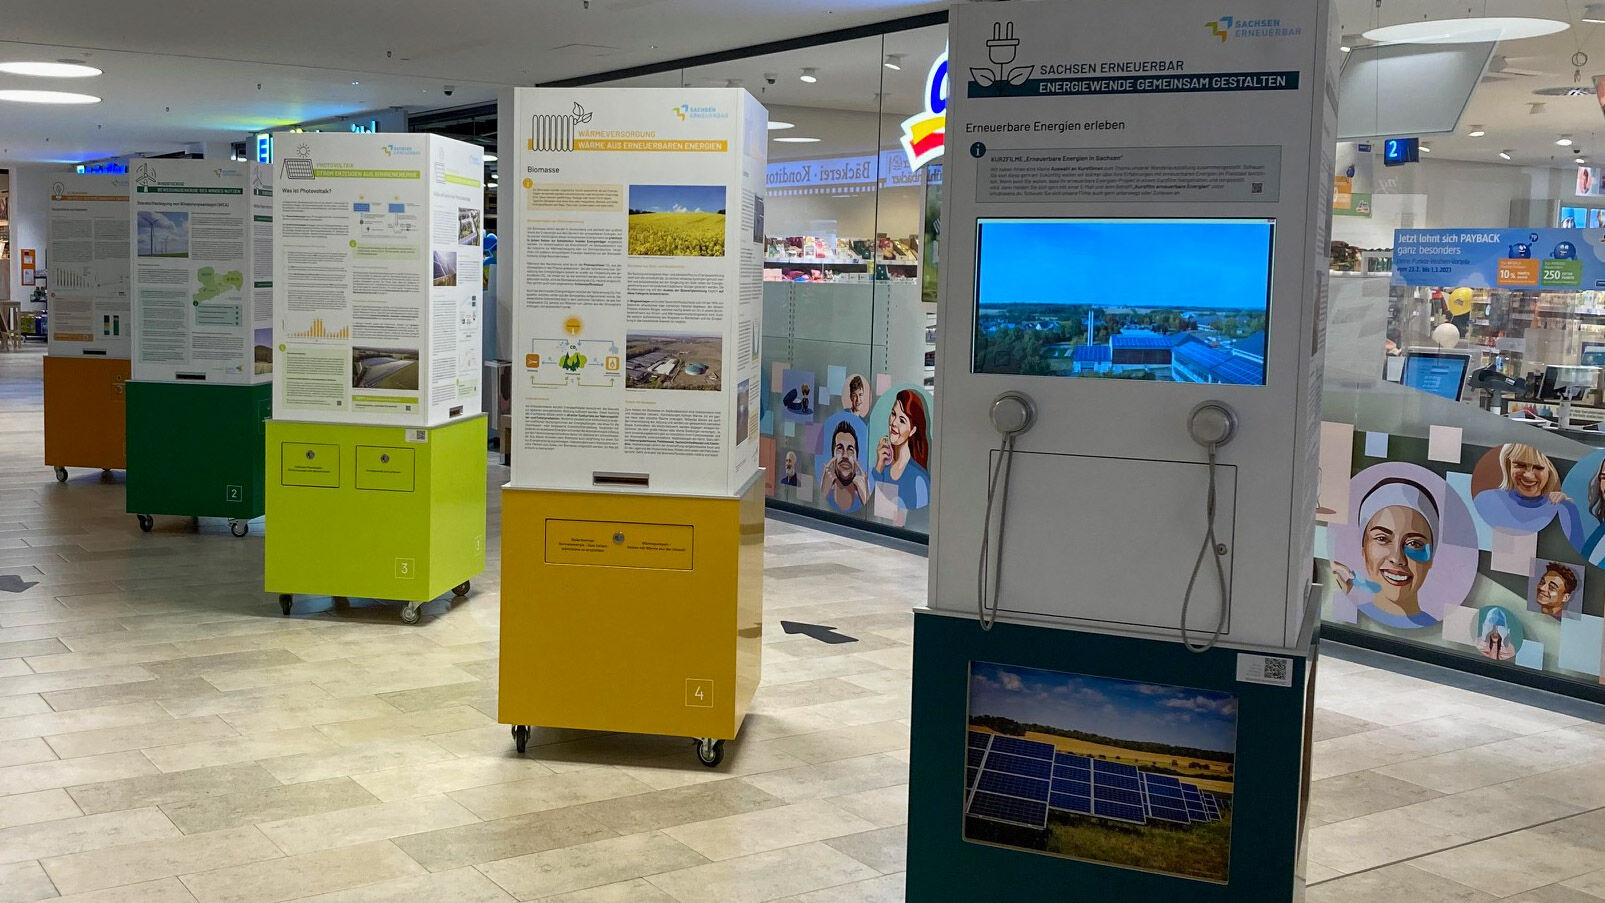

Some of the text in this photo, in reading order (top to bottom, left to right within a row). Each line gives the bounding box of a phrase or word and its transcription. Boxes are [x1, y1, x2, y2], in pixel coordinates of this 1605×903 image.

[1235, 19, 1281, 28] SACHSEN
[1235, 28, 1302, 38] ERNEUERBAR
[1040, 60, 1185, 75] SACHSEN ERNEUERBAR
[1039, 75, 1287, 94] ENERGIEWENDE GEMEINSAM GESTALTEN
[966, 119, 1125, 134] Erneuerbare Energien erleben
[578, 141, 723, 151] WÄRME AUS ERNEUERBAREN ENERGIEN
[1389, 140, 1398, 158] 2
[527, 166, 560, 174] Biomasse
[1398, 234, 1500, 243] Jetzt lohnt sich PAYBACK
[1397, 246, 1461, 256] ganz besonders
[1500, 270, 1509, 279] 10
[1544, 270, 1561, 280] 250
[231, 488, 238, 498] 2
[401, 562, 408, 574] 3
[694, 686, 704, 701] 4
